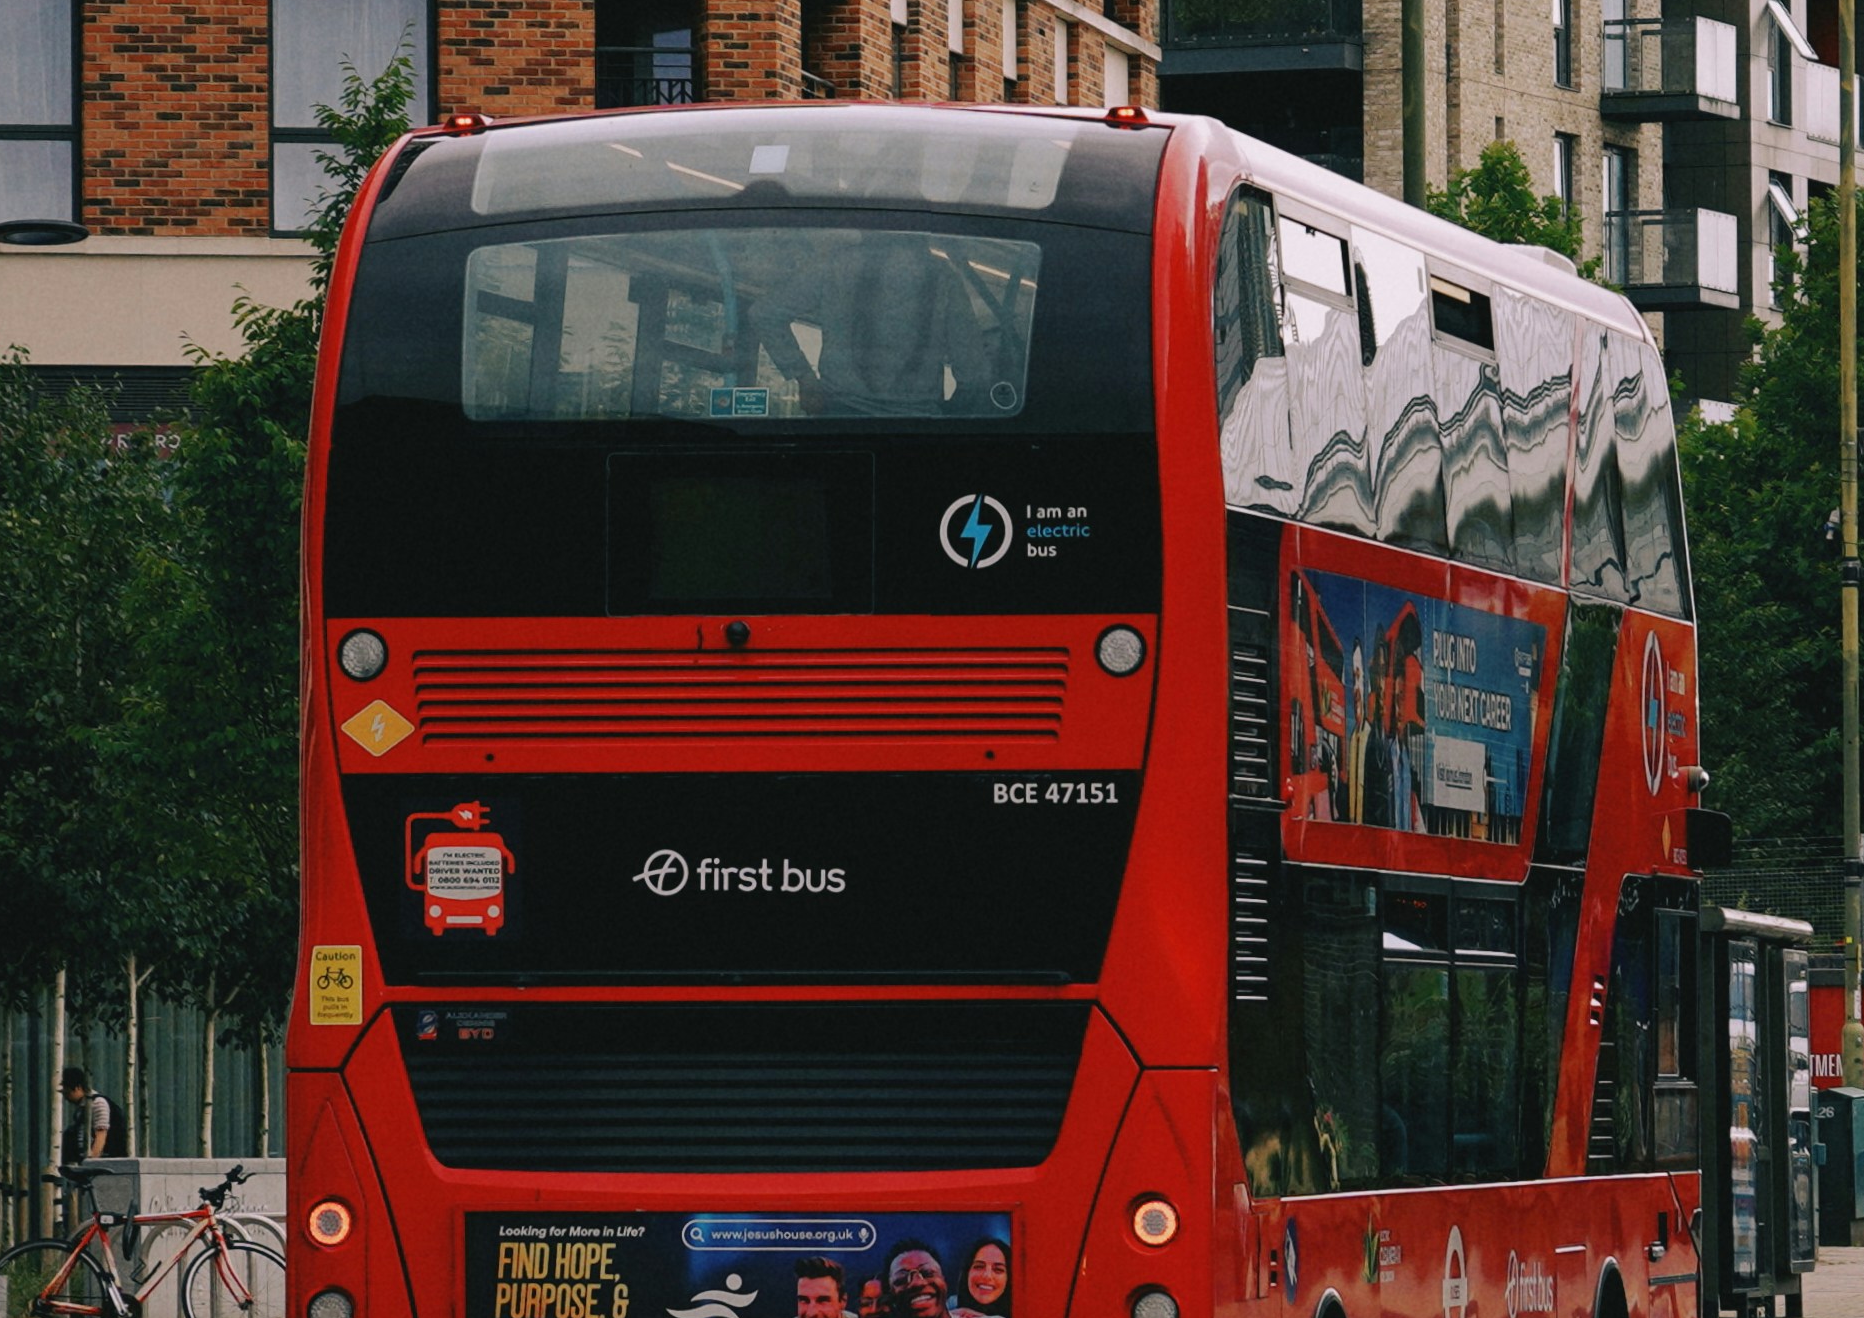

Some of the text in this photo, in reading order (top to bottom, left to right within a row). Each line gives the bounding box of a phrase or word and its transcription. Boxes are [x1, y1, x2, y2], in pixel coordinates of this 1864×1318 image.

[1026, 505, 1088, 519] I am an
[1027, 523, 1091, 538] electric
[1027, 543, 1057, 557] bus
[1433, 630, 1455, 669] PLUG
[1456, 636, 1477, 674] INTO
[1434, 683, 1512, 731] YOUR NEXT CAREER
[993, 782, 1119, 804] BCE 47151
[696, 858, 846, 892] first bus
[315, 951, 356, 961] Caution
[499, 1226, 645, 1239] Looking for More in Life?
[711, 1228, 853, 1242] www.jesushouse.org.uk
[497, 1242, 621, 1283] FIND HOPE,
